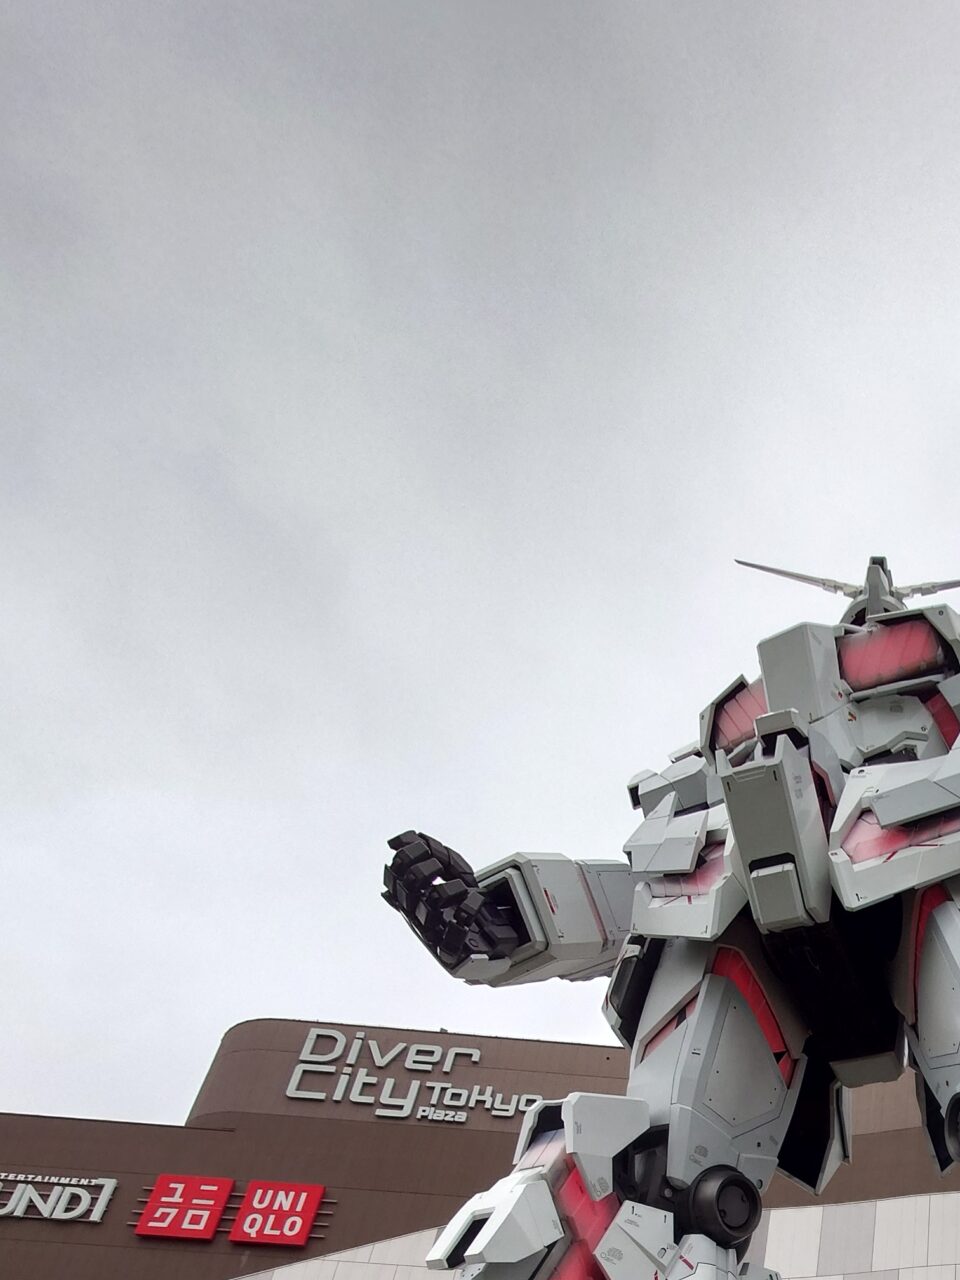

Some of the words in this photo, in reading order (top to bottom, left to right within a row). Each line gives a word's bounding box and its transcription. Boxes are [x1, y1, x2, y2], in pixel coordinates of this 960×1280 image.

[299, 1027, 481, 1073] Diver
[285, 1062, 421, 1118] City
[416, 1106, 468, 1122] Plaza
[160, 1183, 218, 1205] ユニ
[252, 1188, 308, 1213] UNI
[147, 1208, 210, 1231] クロ
[242, 1213, 304, 1238] QLO
